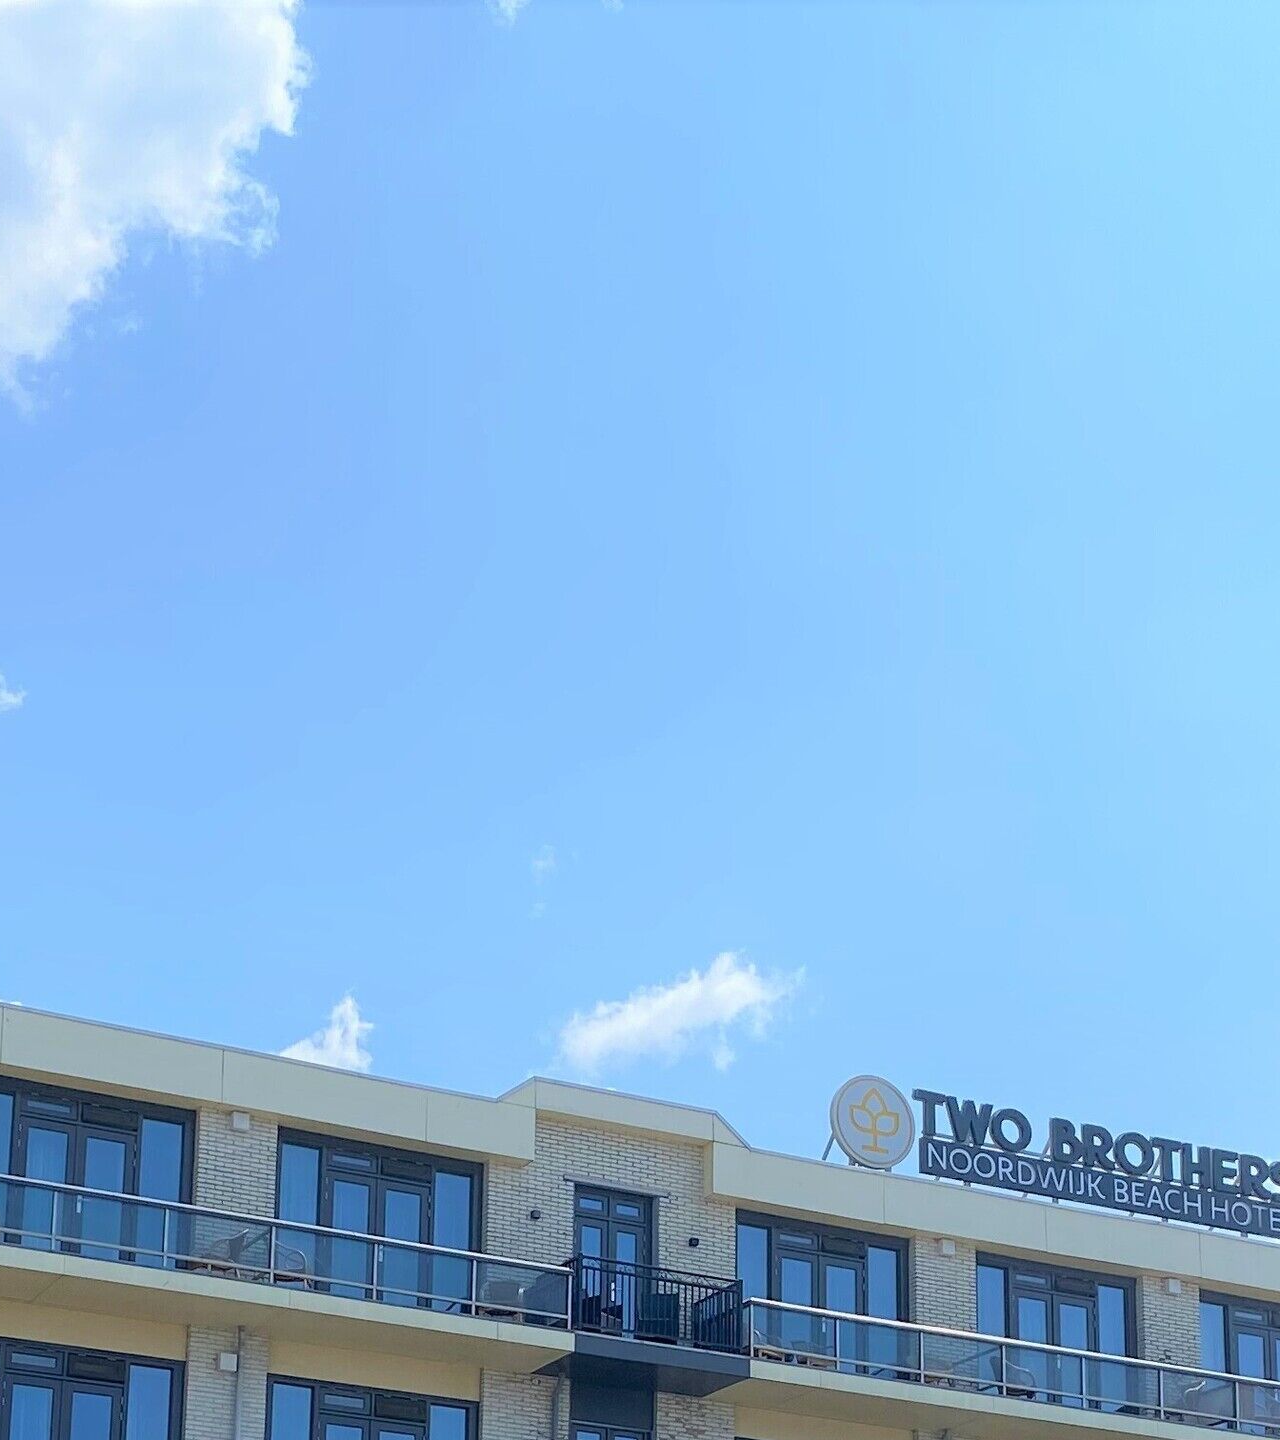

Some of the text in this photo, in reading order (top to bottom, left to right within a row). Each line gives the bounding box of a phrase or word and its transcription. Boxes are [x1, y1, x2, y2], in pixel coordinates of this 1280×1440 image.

[912, 1088, 1033, 1152] TWO
[926, 1142, 1107, 1200] NOORDWIJK
[1113, 1178, 1203, 1218] BEACH
